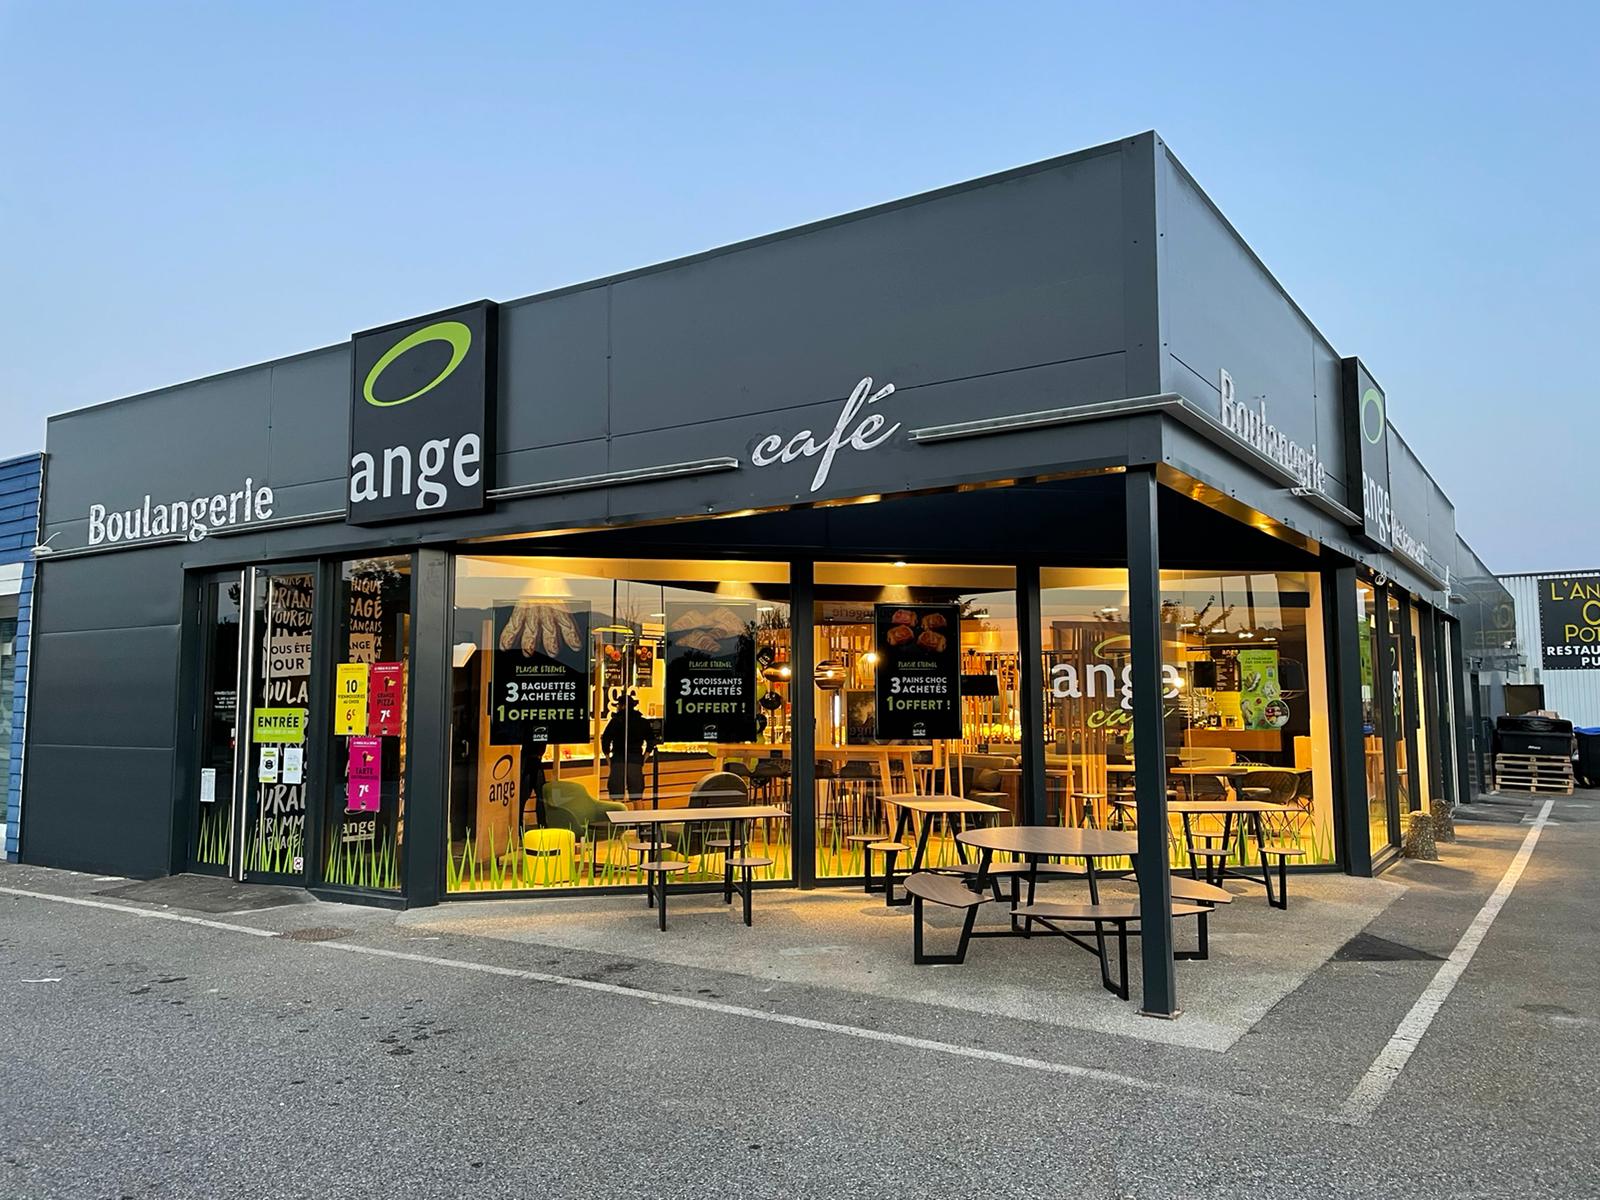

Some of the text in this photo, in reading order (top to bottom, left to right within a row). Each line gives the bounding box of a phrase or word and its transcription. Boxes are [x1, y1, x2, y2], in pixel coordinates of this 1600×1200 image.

[752, 376, 901, 492] café
[1219, 367, 1327, 496] Boulangerie
[350, 433, 481, 511] ange
[87, 477, 274, 544] Boulangerie
[1362, 471, 1391, 543] ange
[349, 641, 370, 649] NGE
[346, 680, 358, 693] 10
[505, 682, 576, 702] 3 BAGUETTES
[680, 678, 691, 696] 3
[693, 685, 742, 695] ACHETÉS
[890, 677, 901, 694] 3
[902, 684, 947, 693] ACHETÉS
[521, 690, 576, 701] ACHETÉES
[886, 696, 951, 711] 1 OFFERT !
[497, 705, 584, 722] 1 OFFERTE !
[675, 698, 746, 714] 1 OFFERT !
[258, 713, 299, 728] ENTRÉE
[489, 781, 515, 806] ange
